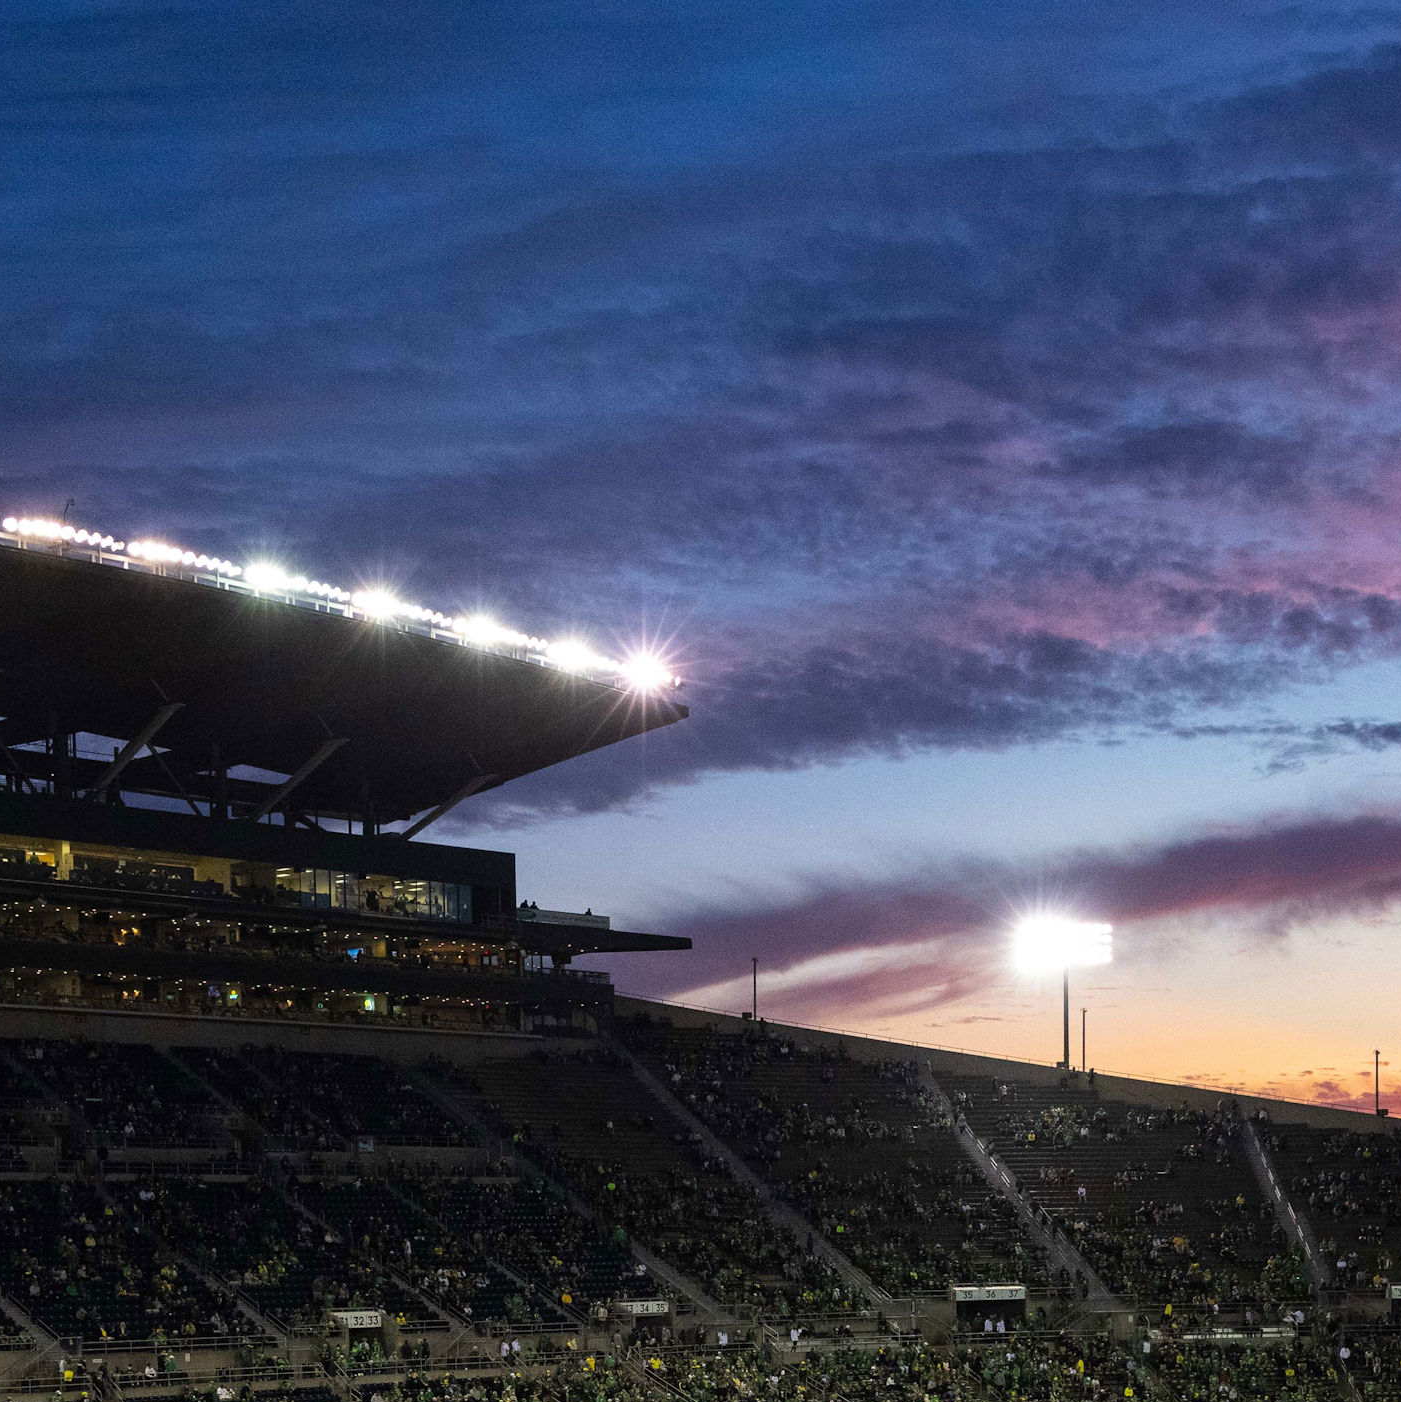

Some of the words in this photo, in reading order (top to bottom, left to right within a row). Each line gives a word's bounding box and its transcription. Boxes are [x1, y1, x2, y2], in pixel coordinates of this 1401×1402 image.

[961, 1290, 974, 1300] 35
[985, 1289, 997, 1299] 36
[1008, 1289, 1020, 1299] 37
[639, 1303, 650, 1313] 34
[655, 1303, 666, 1312] 35
[352, 1315, 366, 1326] 32
[367, 1315, 380, 1326] 33
